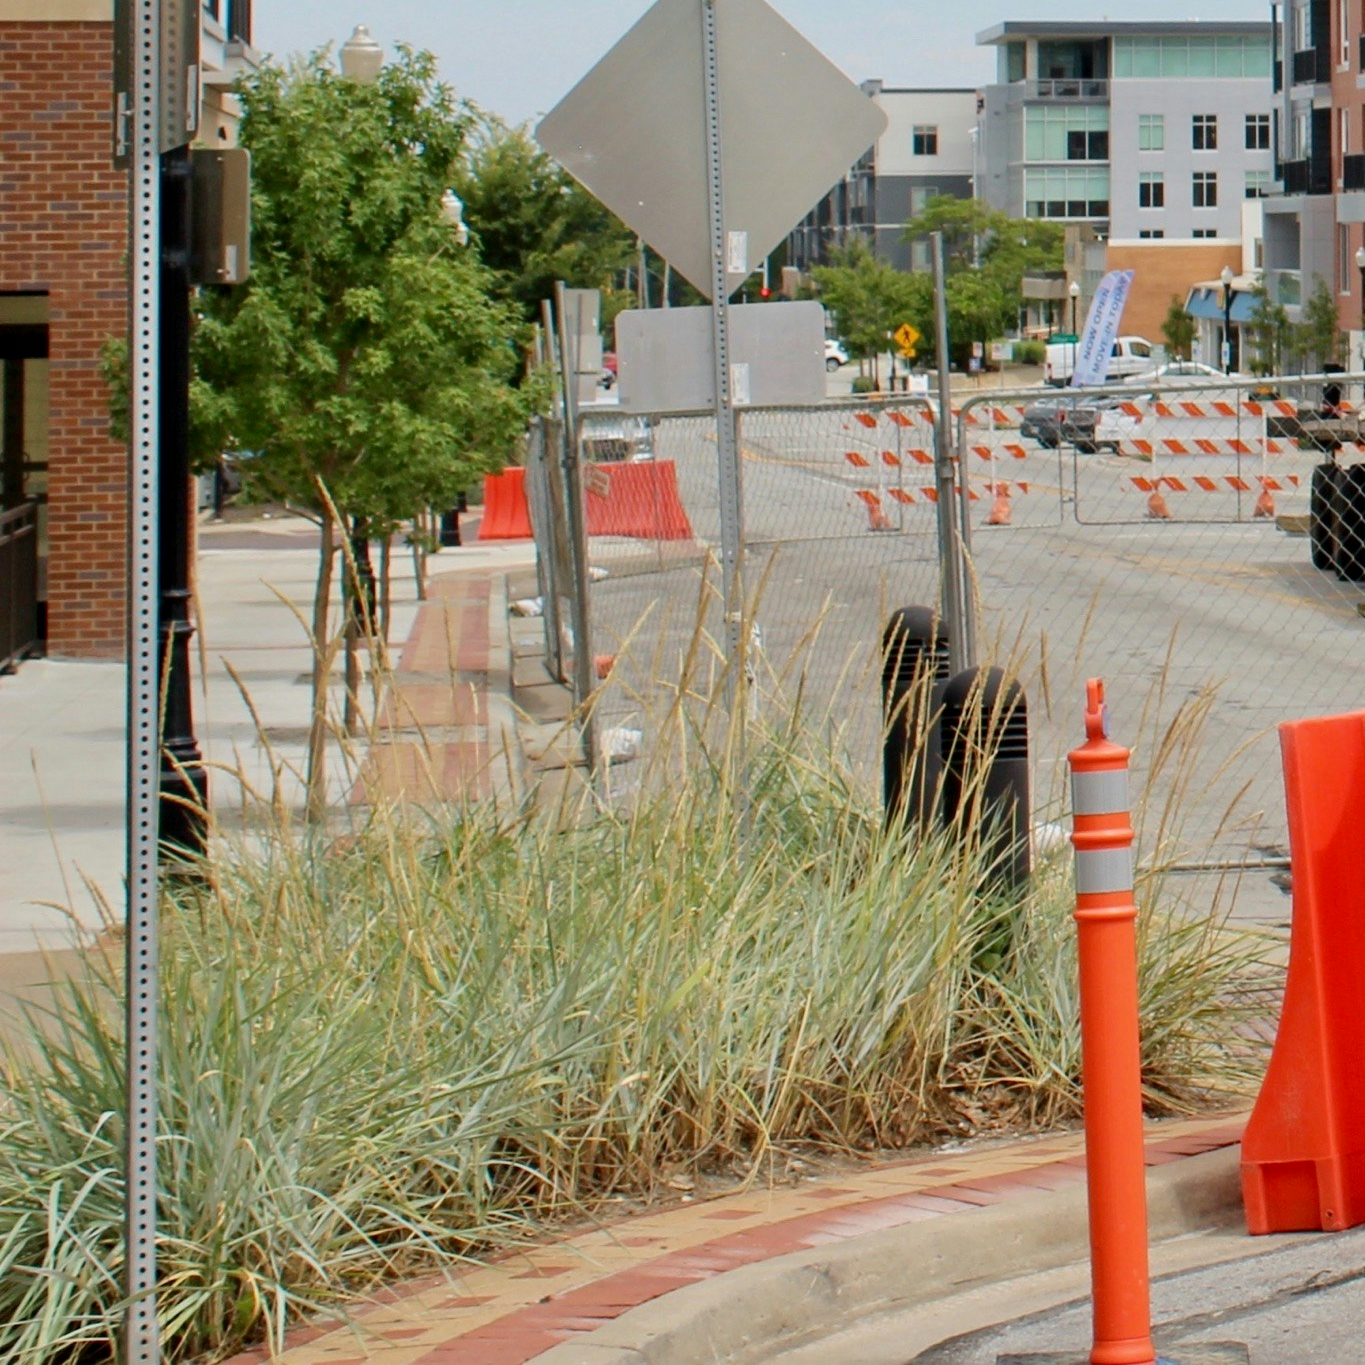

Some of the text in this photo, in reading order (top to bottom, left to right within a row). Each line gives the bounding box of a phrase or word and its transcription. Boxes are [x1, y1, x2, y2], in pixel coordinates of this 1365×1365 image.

[1083, 288, 1109, 360] NOW OPEN
[1110, 275, 1127, 317] TODAY
